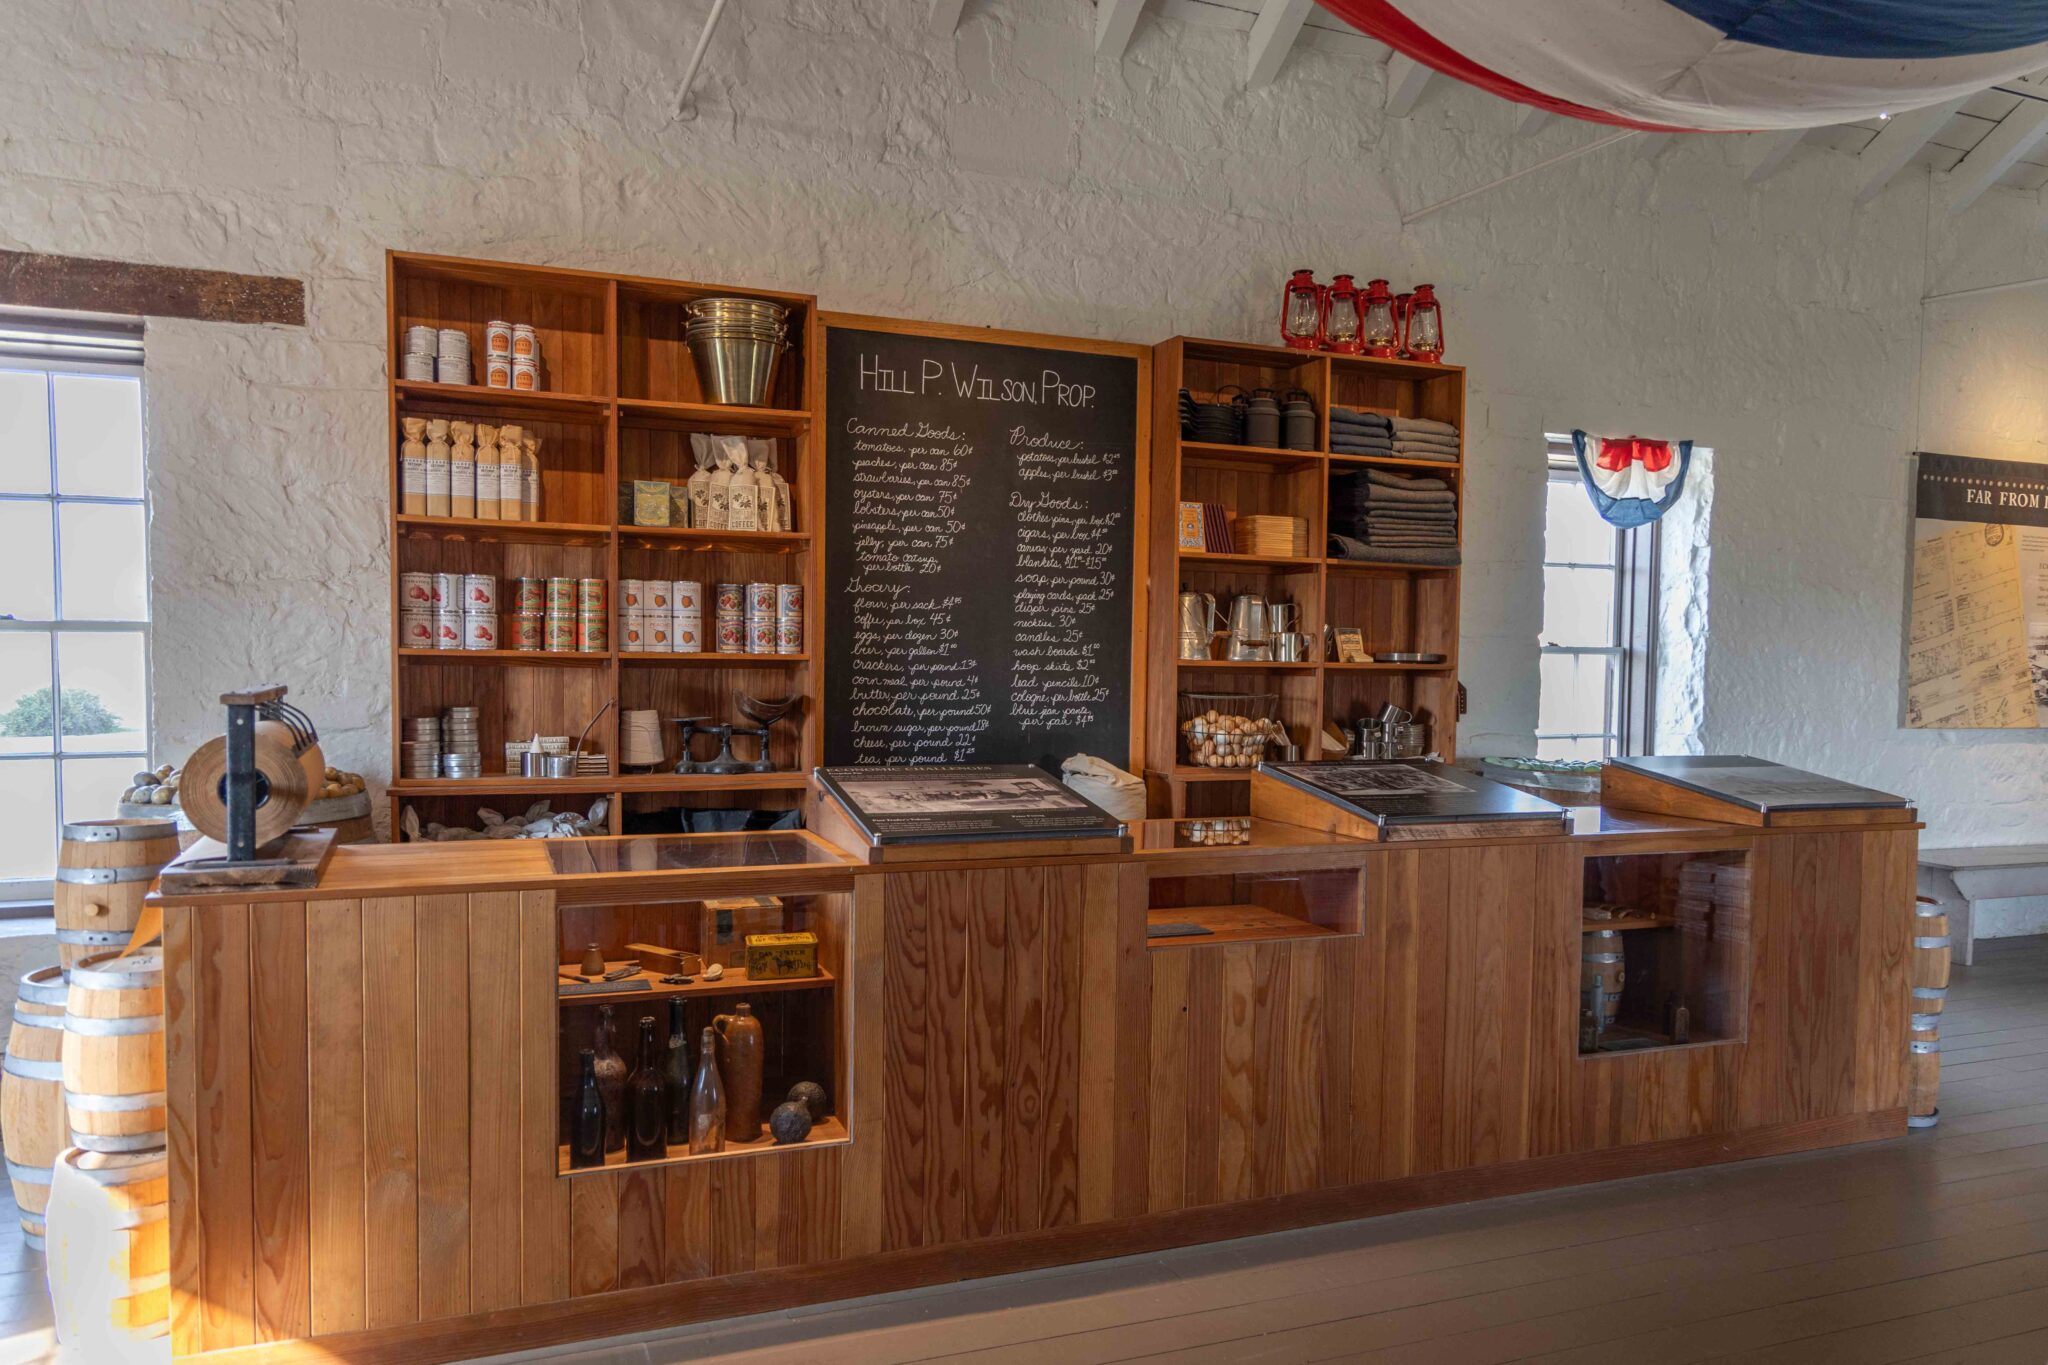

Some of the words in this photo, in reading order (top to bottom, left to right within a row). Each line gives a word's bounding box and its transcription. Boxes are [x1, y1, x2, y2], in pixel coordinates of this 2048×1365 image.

[860, 354, 915, 394] HILL
[922, 359, 942, 395] P.
[1042, 370, 1096, 408] PROP.
[846, 418, 914, 437] Canned
[915, 422, 965, 440] Goods:
[1010, 426, 1084, 450] Produce:
[909, 447, 928, 458] per
[954, 444, 973, 456] 60¢
[900, 461, 918, 472] per
[919, 462, 937, 471] can
[940, 458, 957, 471] 85¢
[1057, 456, 1072, 467] per
[934, 478, 950, 486] can
[952, 475, 971, 487] 85¢
[1052, 472, 1070, 482] per
[896, 494, 914, 504] per
[915, 494, 934, 502] can
[939, 491, 957, 503] 75¢
[1009, 491, 1037, 513] Dry
[1037, 491, 1088, 509] Goods:
[1966, 488, 1992, 504] FAR
[1999, 491, 2040, 508] FROM
[900, 510, 920, 521] per
[921, 510, 938, 518] can
[938, 506, 955, 518] 50¢
[902, 525, 922, 535] per
[925, 525, 943, 533] can
[945, 521, 965, 533] 50¢
[1052, 531, 1070, 543] per
[1071, 527, 1091, 541] box
[888, 540, 908, 552] per
[912, 540, 932, 548] can
[935, 535, 954, 548] 75¢
[1049, 546, 1068, 557] per
[1070, 545, 1092, 557] yard
[1095, 543, 1113, 555] 20¢
[856, 551, 899, 562] tomato
[863, 564, 885, 575] per
[885, 563, 914, 572] bottle
[920, 564, 941, 574] 20¢
[1050, 576, 1068, 588] per
[1068, 576, 1099, 589] pound
[1100, 571, 1115, 586] 30¢
[844, 576, 910, 600] Grocery:
[1013, 588, 1045, 604] playing
[1098, 588, 1114, 600] 25¢
[890, 602, 911, 613] per
[1014, 602, 1049, 616] diaper
[1051, 603, 1075, 617] pins
[1079, 603, 1095, 614] 25¢
[886, 618, 902, 629] per
[905, 614, 926, 627] box
[1013, 619, 1055, 628] neckties
[1059, 615, 1076, 628] 30¢
[882, 633, 902, 644] per
[905, 630, 937, 644] dozen
[940, 628, 958, 640] 30¢
[1015, 631, 1060, 642] candles
[1063, 630, 1083, 642] 25¢
[885, 647, 907, 658] per
[909, 646, 939, 660] gallon
[1013, 646, 1045, 657] wash
[1046, 645, 1080, 656] boards
[908, 662, 929, 675] per
[1011, 660, 1041, 674] hoop
[1044, 661, 1075, 671] skirts
[852, 676, 882, 684] corn
[909, 678, 929, 689] per
[931, 678, 966, 688] pound
[1010, 674, 1038, 687] lead
[1042, 676, 1080, 692] pencils
[1080, 674, 1100, 687] 10¢
[891, 692, 918, 704] per
[918, 690, 959, 704] pound
[962, 689, 980, 700] 25¢
[1051, 695, 1067, 706] per
[1067, 689, 1092, 702] bottle
[1092, 688, 1109, 702] 25¢
[917, 708, 938, 720] per
[939, 705, 975, 721] pound
[974, 704, 991, 716] 50¢
[1010, 703, 1038, 715] blue
[851, 721, 892, 732] brown
[927, 725, 946, 736] per
[946, 722, 976, 736] pound
[1019, 719, 1043, 731] per
[889, 739, 910, 751] per
[913, 737, 954, 751] pound
[885, 755, 906, 767] per
[909, 753, 948, 766] pound
